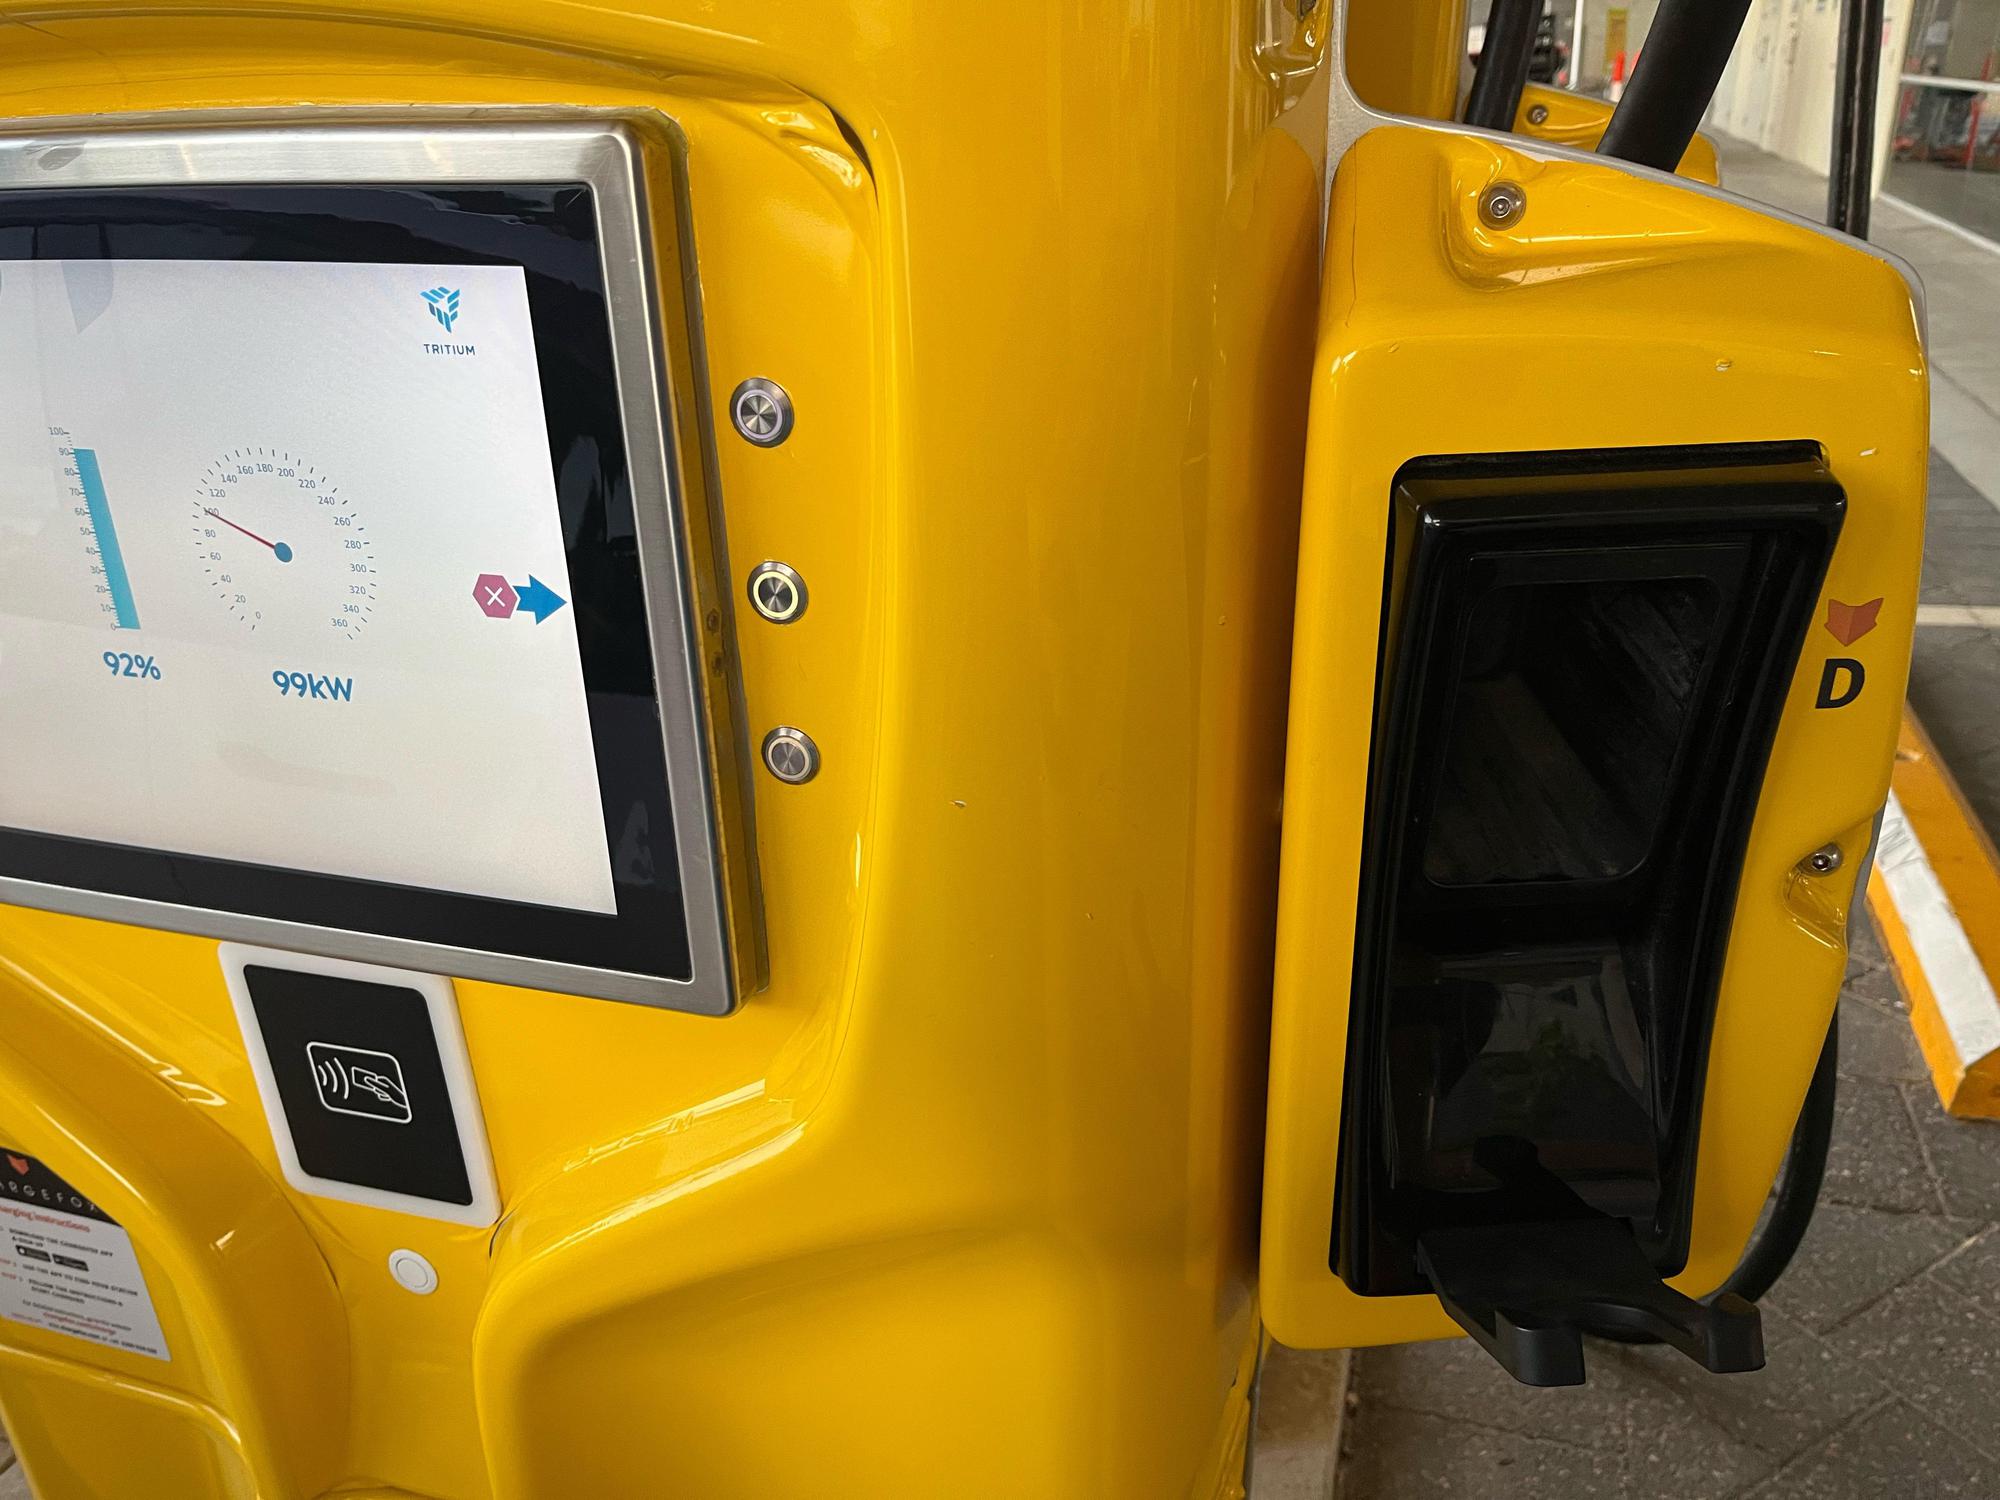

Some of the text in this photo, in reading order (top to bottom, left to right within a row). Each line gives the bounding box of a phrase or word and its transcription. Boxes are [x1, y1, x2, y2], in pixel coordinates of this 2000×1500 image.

[423, 343, 476, 356] TRITIUM
[48, 427, 64, 436] 100
[236, 465, 254, 475] 160
[256, 463, 274, 473] 180
[277, 467, 295, 478] 200
[220, 474, 238, 484] 140
[298, 479, 316, 489] 220
[209, 488, 226, 498] 120
[317, 495, 335, 506] 240
[203, 507, 220, 517] 100
[333, 516, 351, 527] 260
[204, 529, 216, 538] 80
[344, 539, 362, 550] 280
[210, 552, 222, 561] 60
[350, 563, 367, 573] 300
[221, 574, 232, 583] 40
[349, 585, 366, 595] 320
[234, 594, 246, 604] 20
[343, 604, 360, 614] 340
[255, 611, 262, 620] 0
[331, 618, 348, 628] 360
[103, 651, 162, 681] 92%
[272, 670, 353, 702] 99kW
[1815, 658, 1866, 710] D
